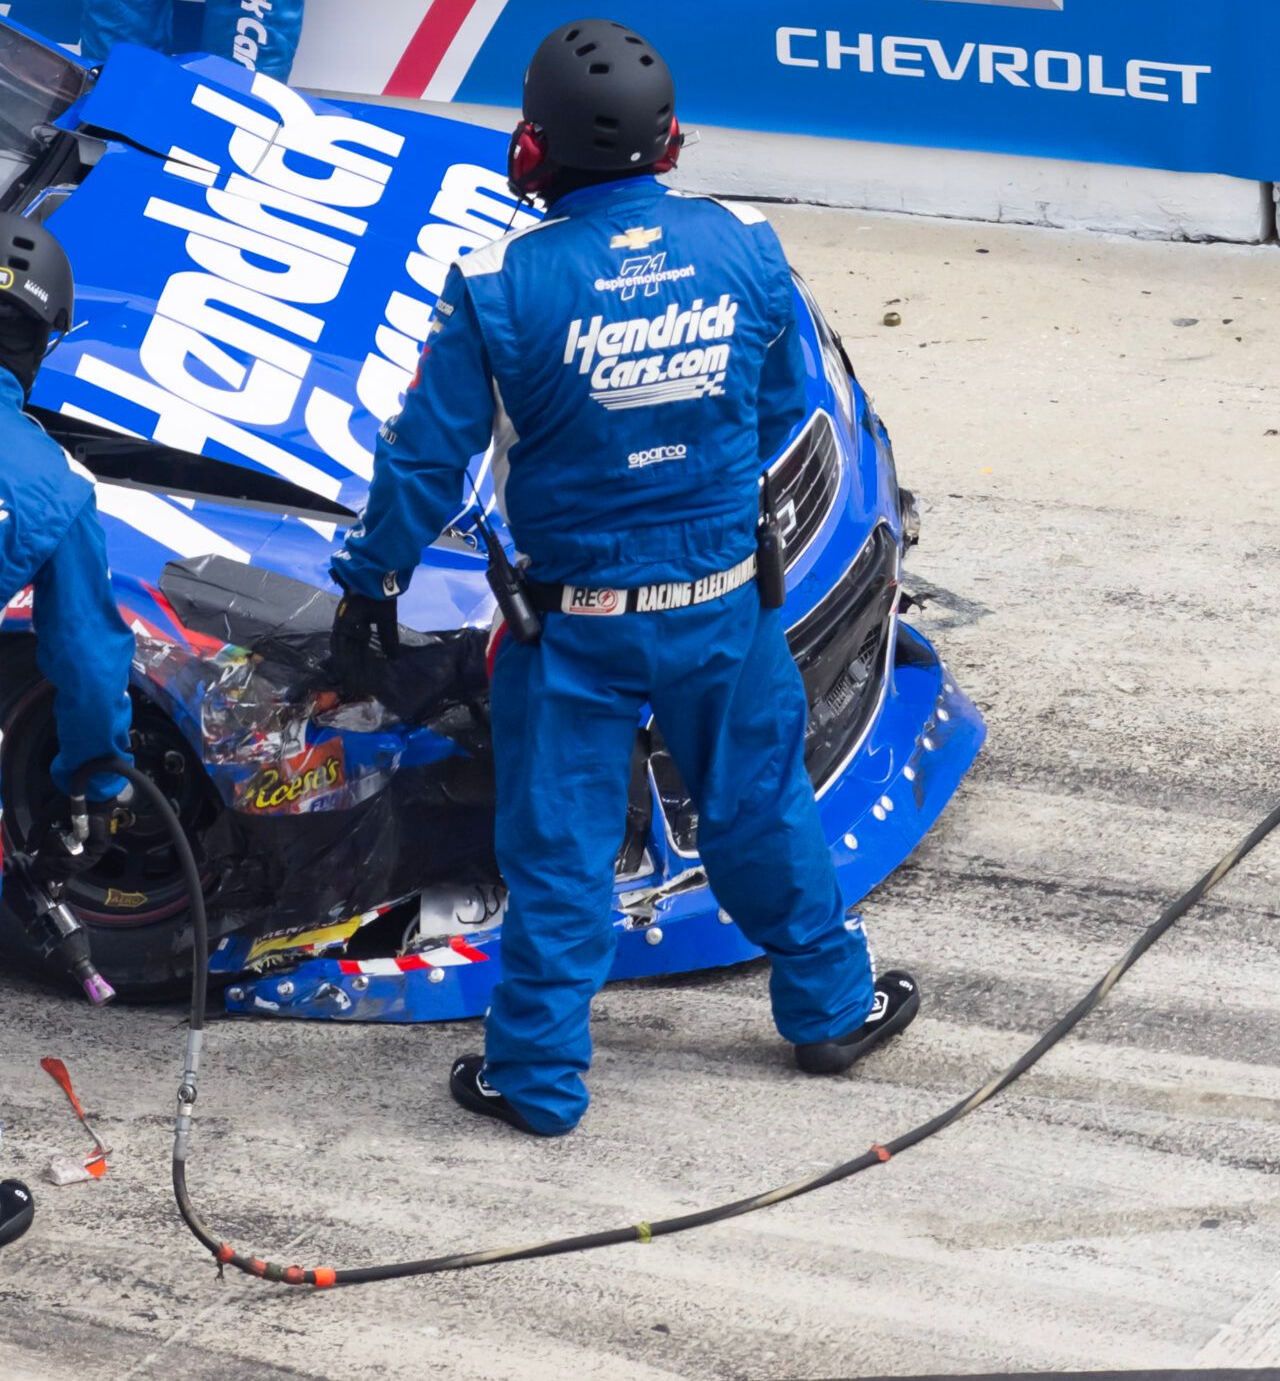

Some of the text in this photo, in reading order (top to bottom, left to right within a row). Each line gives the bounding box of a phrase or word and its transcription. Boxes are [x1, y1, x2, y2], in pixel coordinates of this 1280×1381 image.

[775, 26, 1212, 106] CHEVROLET
[594, 263, 696, 293] @spiremotorsport
[562, 293, 739, 375] Hendrick
[590, 343, 730, 391] Cars.com
[627, 443, 688, 470] sparco
[636, 582, 692, 613] RACING
